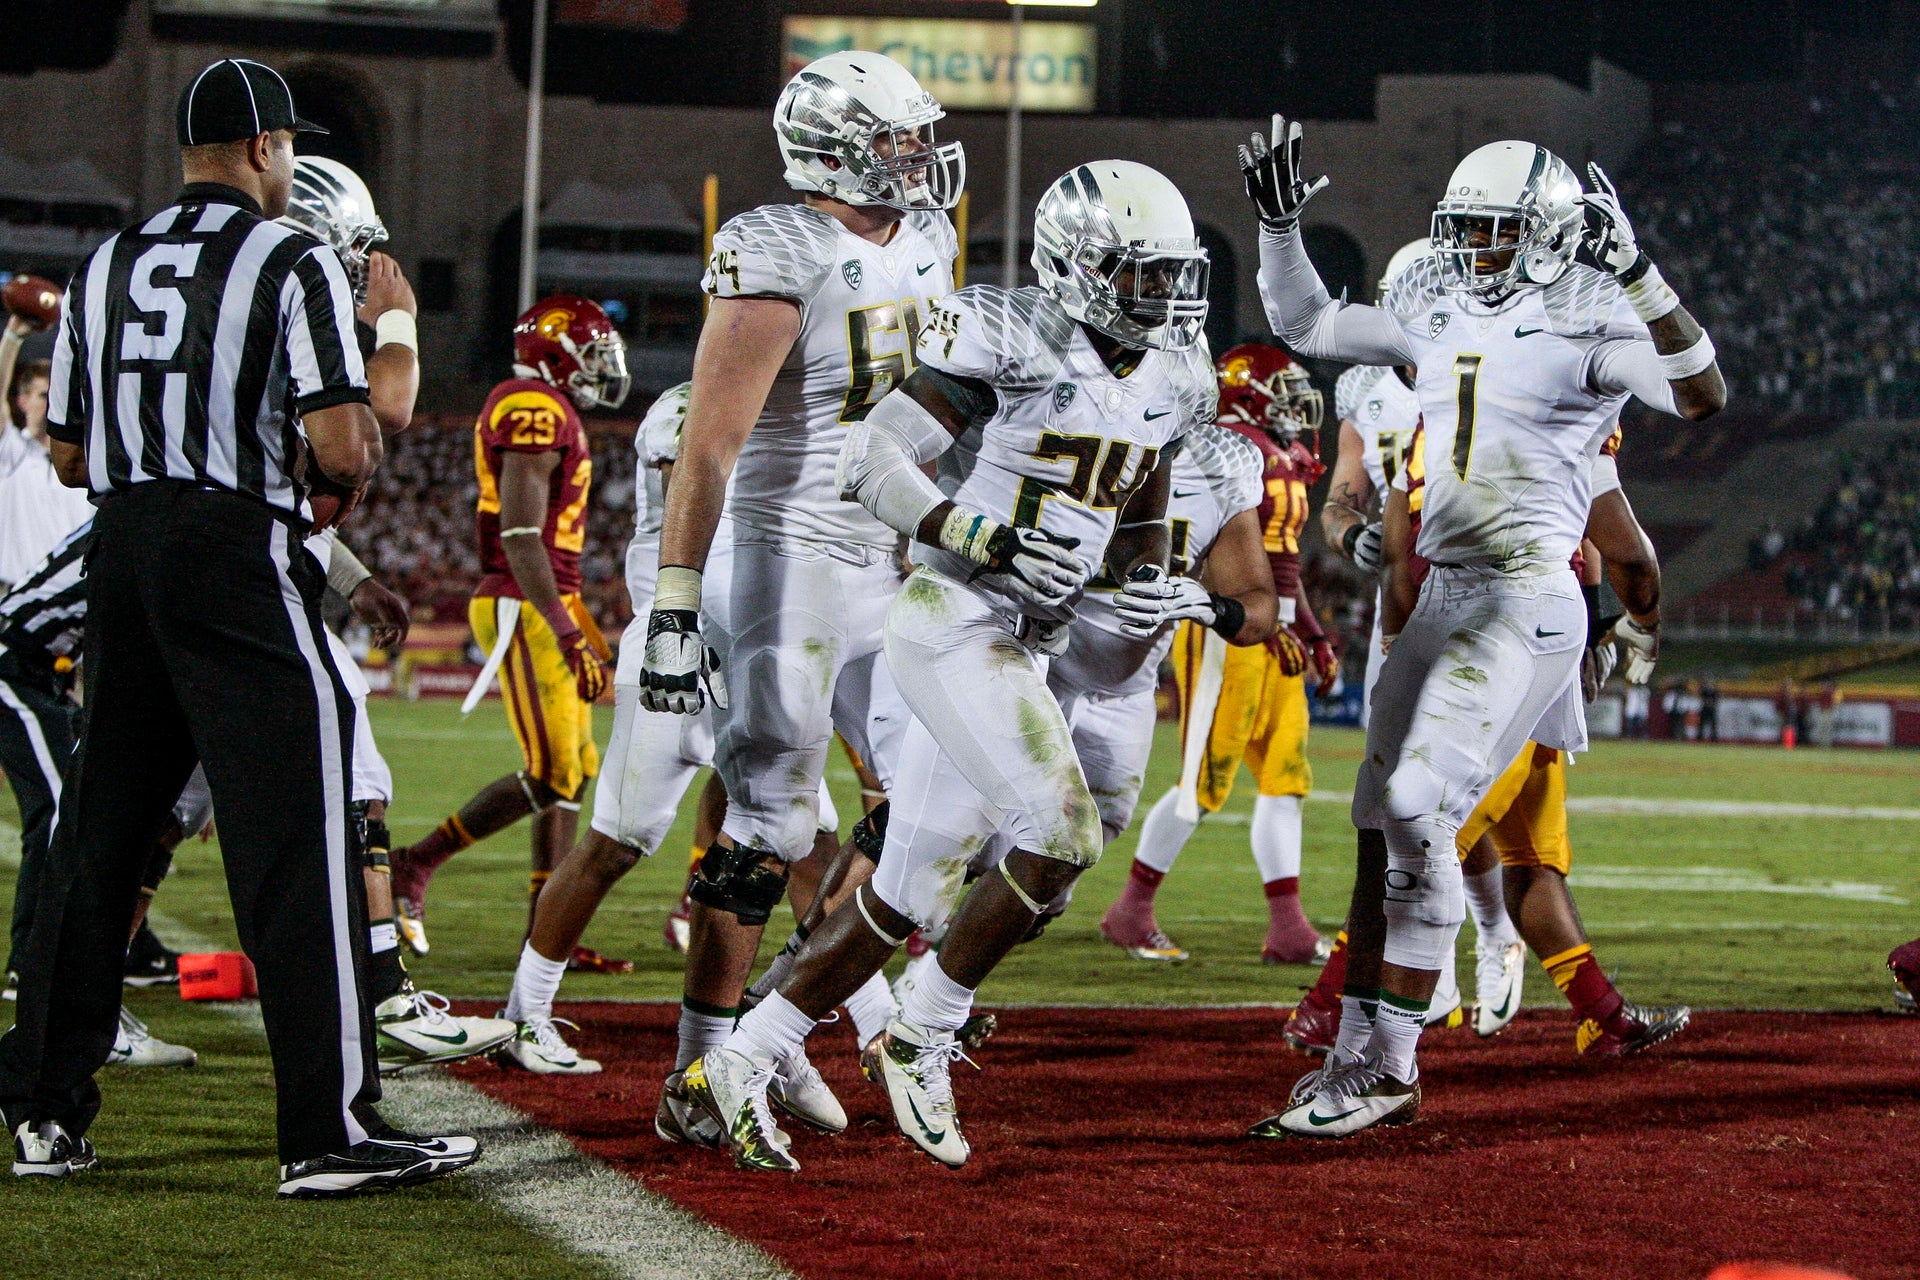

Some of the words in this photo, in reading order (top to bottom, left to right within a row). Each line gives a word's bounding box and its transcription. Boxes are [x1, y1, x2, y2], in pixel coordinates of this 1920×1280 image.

[1128, 239, 1147, 248] NIKE
[120, 242, 205, 361] S
[510, 408, 556, 446] 29
[1450, 351, 1485, 484] 1
[1010, 430, 1161, 531] 24
[1377, 429, 1416, 489] 7
[1380, 1005, 1423, 1018] OREGON
